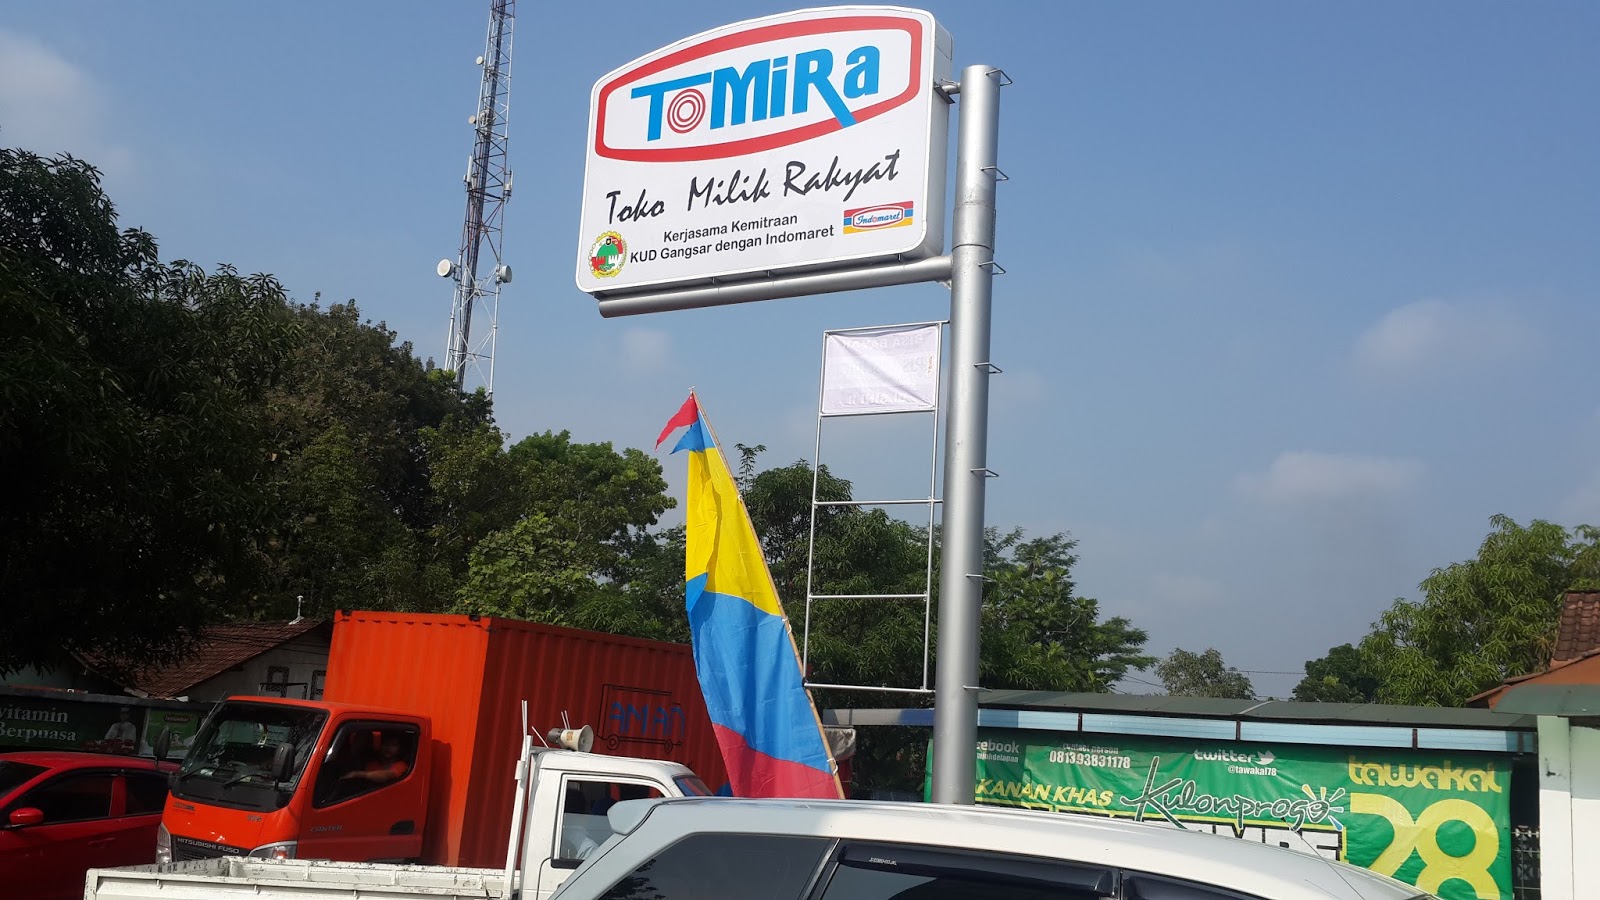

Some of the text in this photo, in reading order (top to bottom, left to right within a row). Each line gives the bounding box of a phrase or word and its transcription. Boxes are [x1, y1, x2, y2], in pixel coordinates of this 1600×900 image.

[606, 148, 900, 225] Toko Milik Rakyat
[855, 211, 900, 225] Indomaret
[663, 215, 798, 243] Kerjasama Kemitraan
[630, 225, 834, 264] KUD Gangsar dengan Indomaret
[1049, 750, 1131, 769] 081393831178
[1194, 748, 1255, 764] twitter
[1348, 755, 1503, 794] tawakal
[1053, 786, 1113, 806] KHAS
[177, 837, 240, 854] MITSUBISHI FUSO
